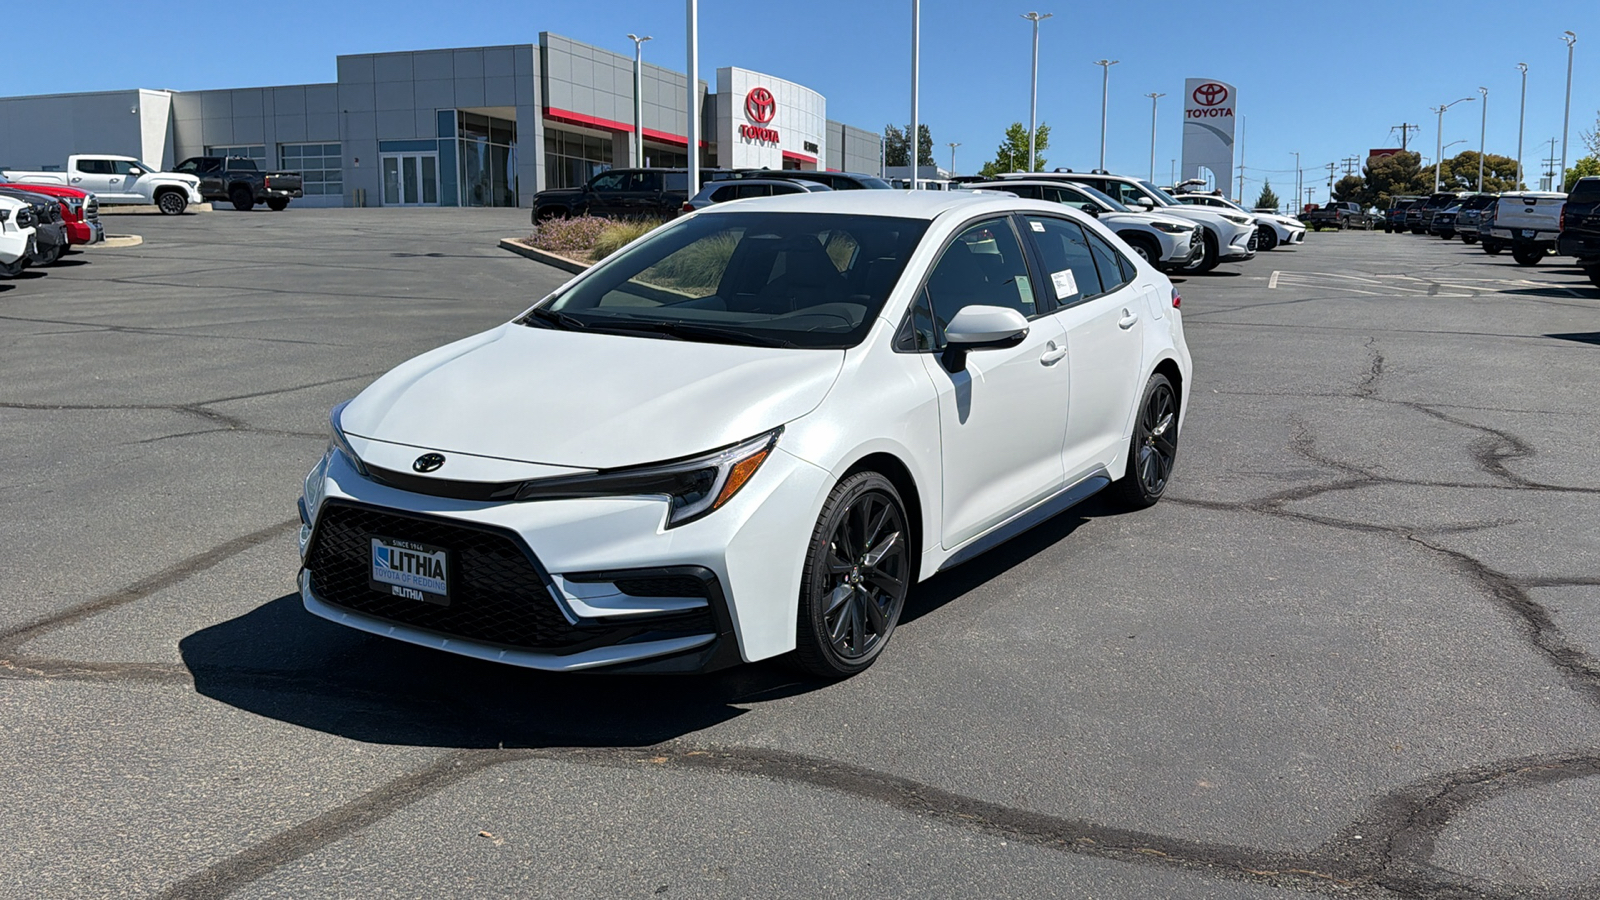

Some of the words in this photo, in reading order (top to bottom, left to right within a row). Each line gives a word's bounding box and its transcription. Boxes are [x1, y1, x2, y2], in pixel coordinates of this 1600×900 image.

[1186, 108, 1233, 118] TOYOTA
[740, 124, 780, 143] TOYOTA
[392, 540, 409, 548] SINCE
[410, 543, 423, 551] 1946
[390, 549, 445, 580] LITHIA
[375, 567, 400, 580] TOYOTA
[402, 573, 412, 583] OF
[413, 576, 446, 591] REDDING
[400, 586, 424, 602] LITHIA
